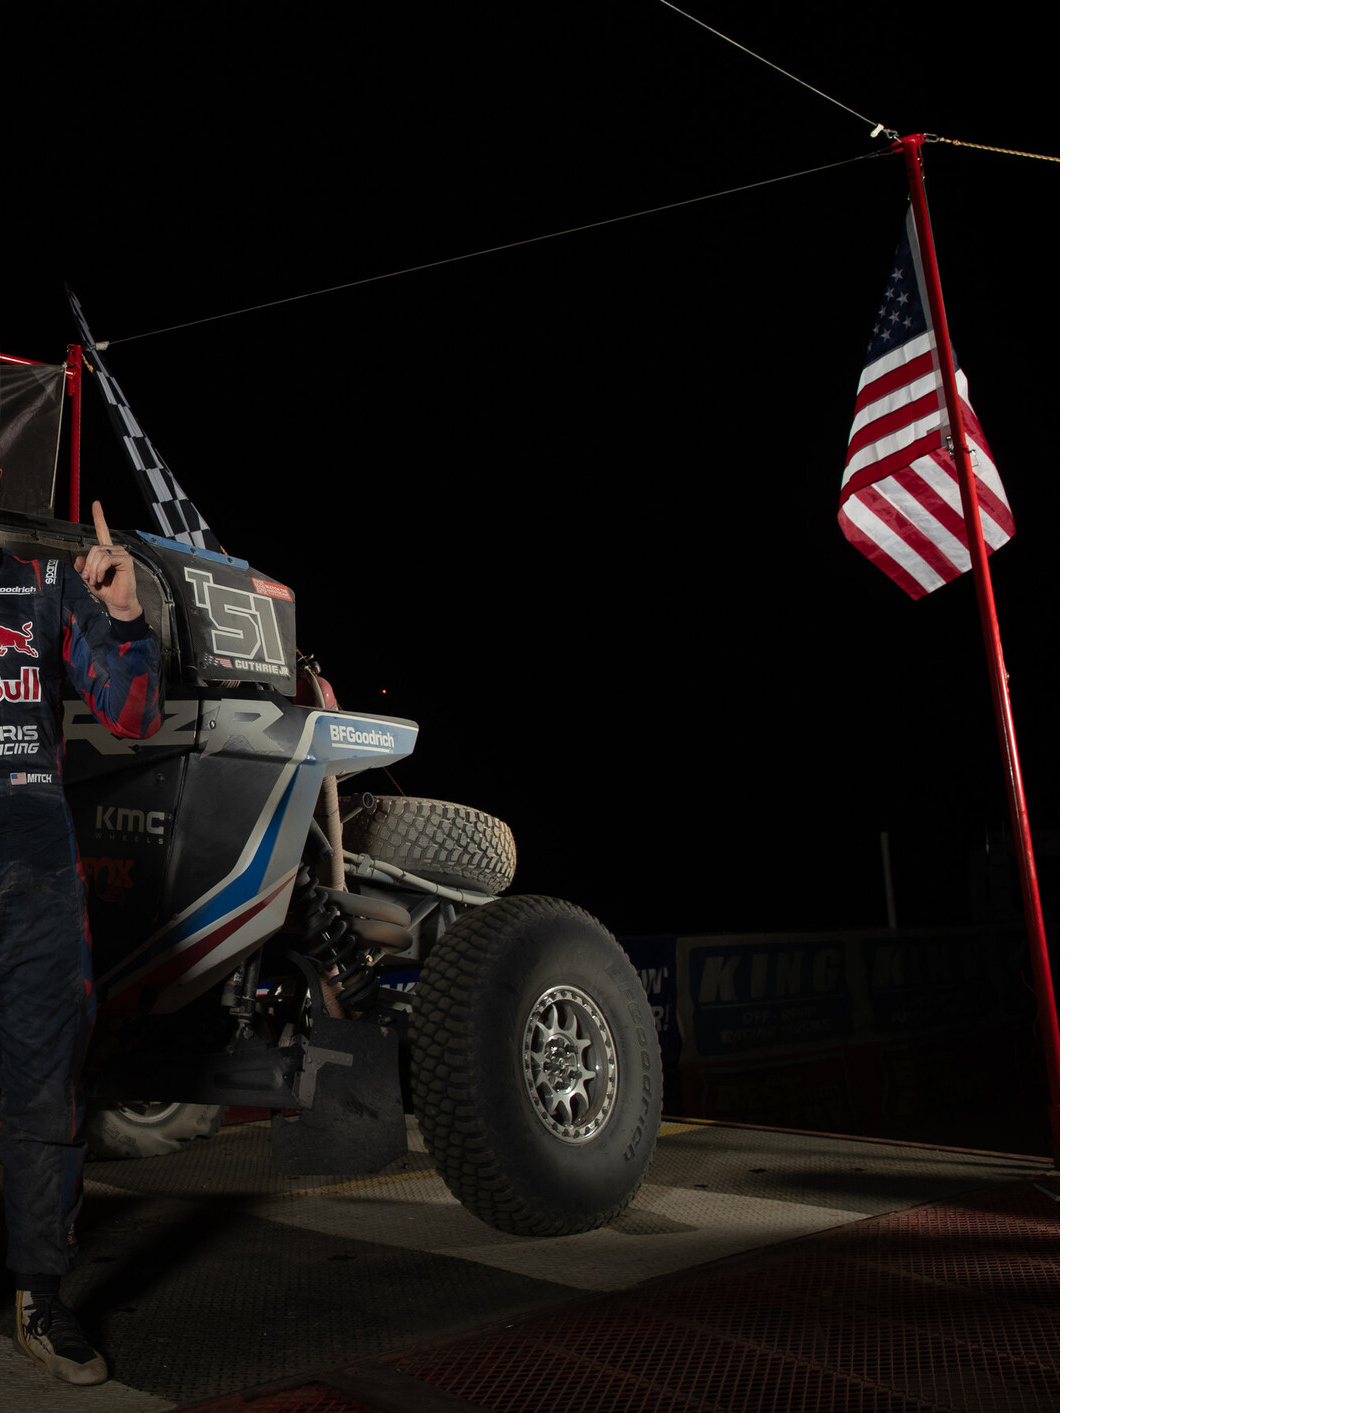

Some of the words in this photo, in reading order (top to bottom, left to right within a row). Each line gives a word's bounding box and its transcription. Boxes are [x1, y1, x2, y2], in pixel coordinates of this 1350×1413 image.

[234, 659, 279, 674] GUTHRIE
[329, 724, 395, 748] BFGoodrich
[27, 773, 52, 784] MITCH
[699, 947, 843, 1003] KING
